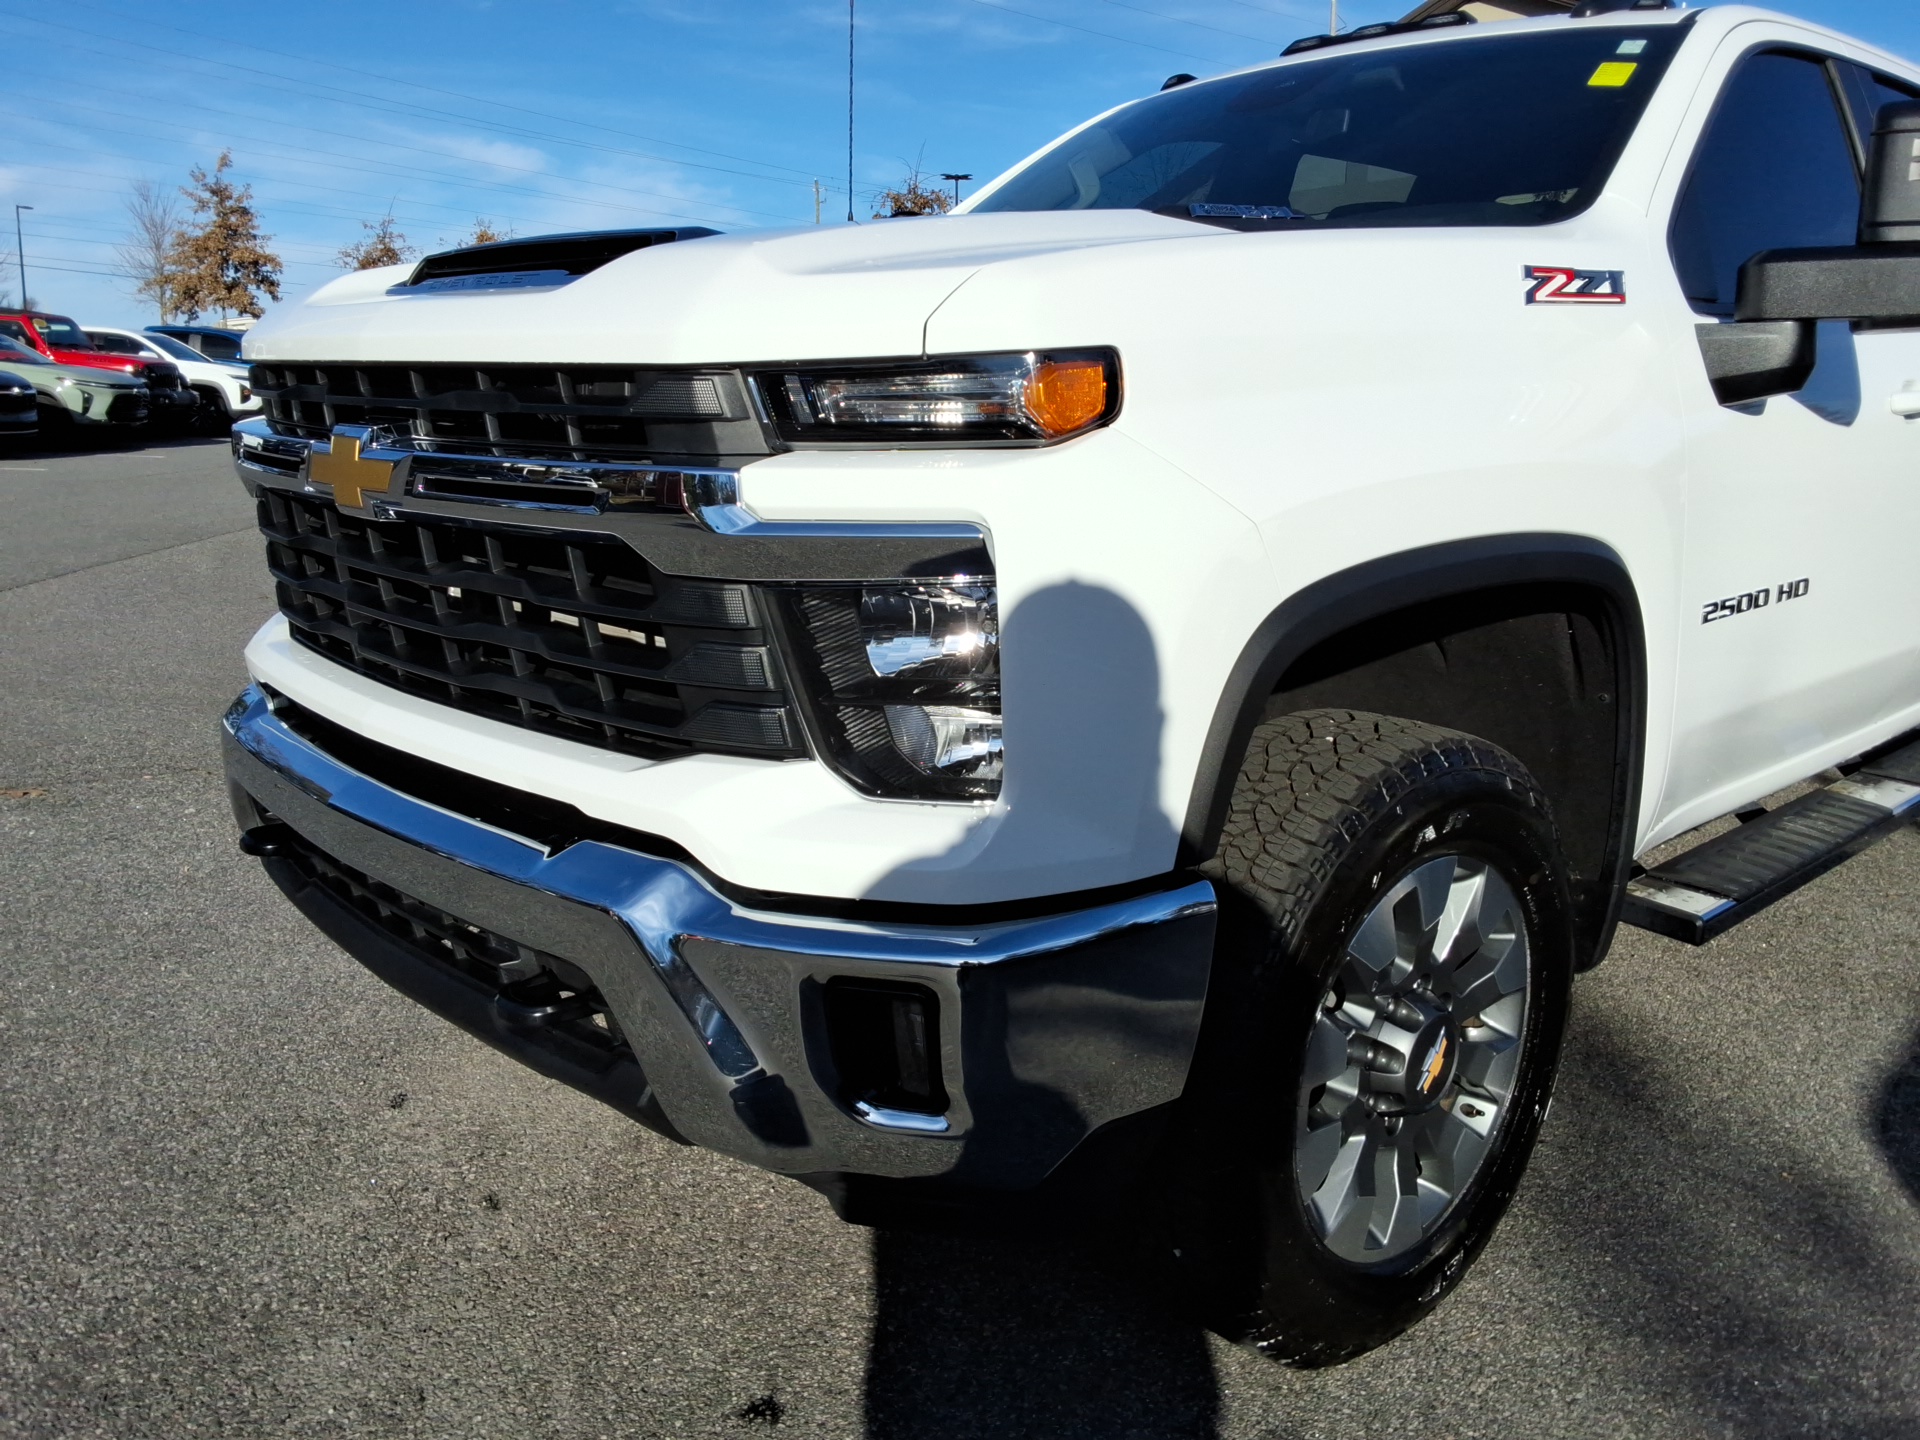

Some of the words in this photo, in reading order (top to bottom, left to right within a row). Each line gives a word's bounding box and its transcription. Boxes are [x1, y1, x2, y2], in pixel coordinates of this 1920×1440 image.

[428, 272, 541, 291] CHEVROLET
[1521, 265, 1627, 306] Z71
[1701, 587, 1770, 625] 2500
[1776, 577, 1810, 604] HD
